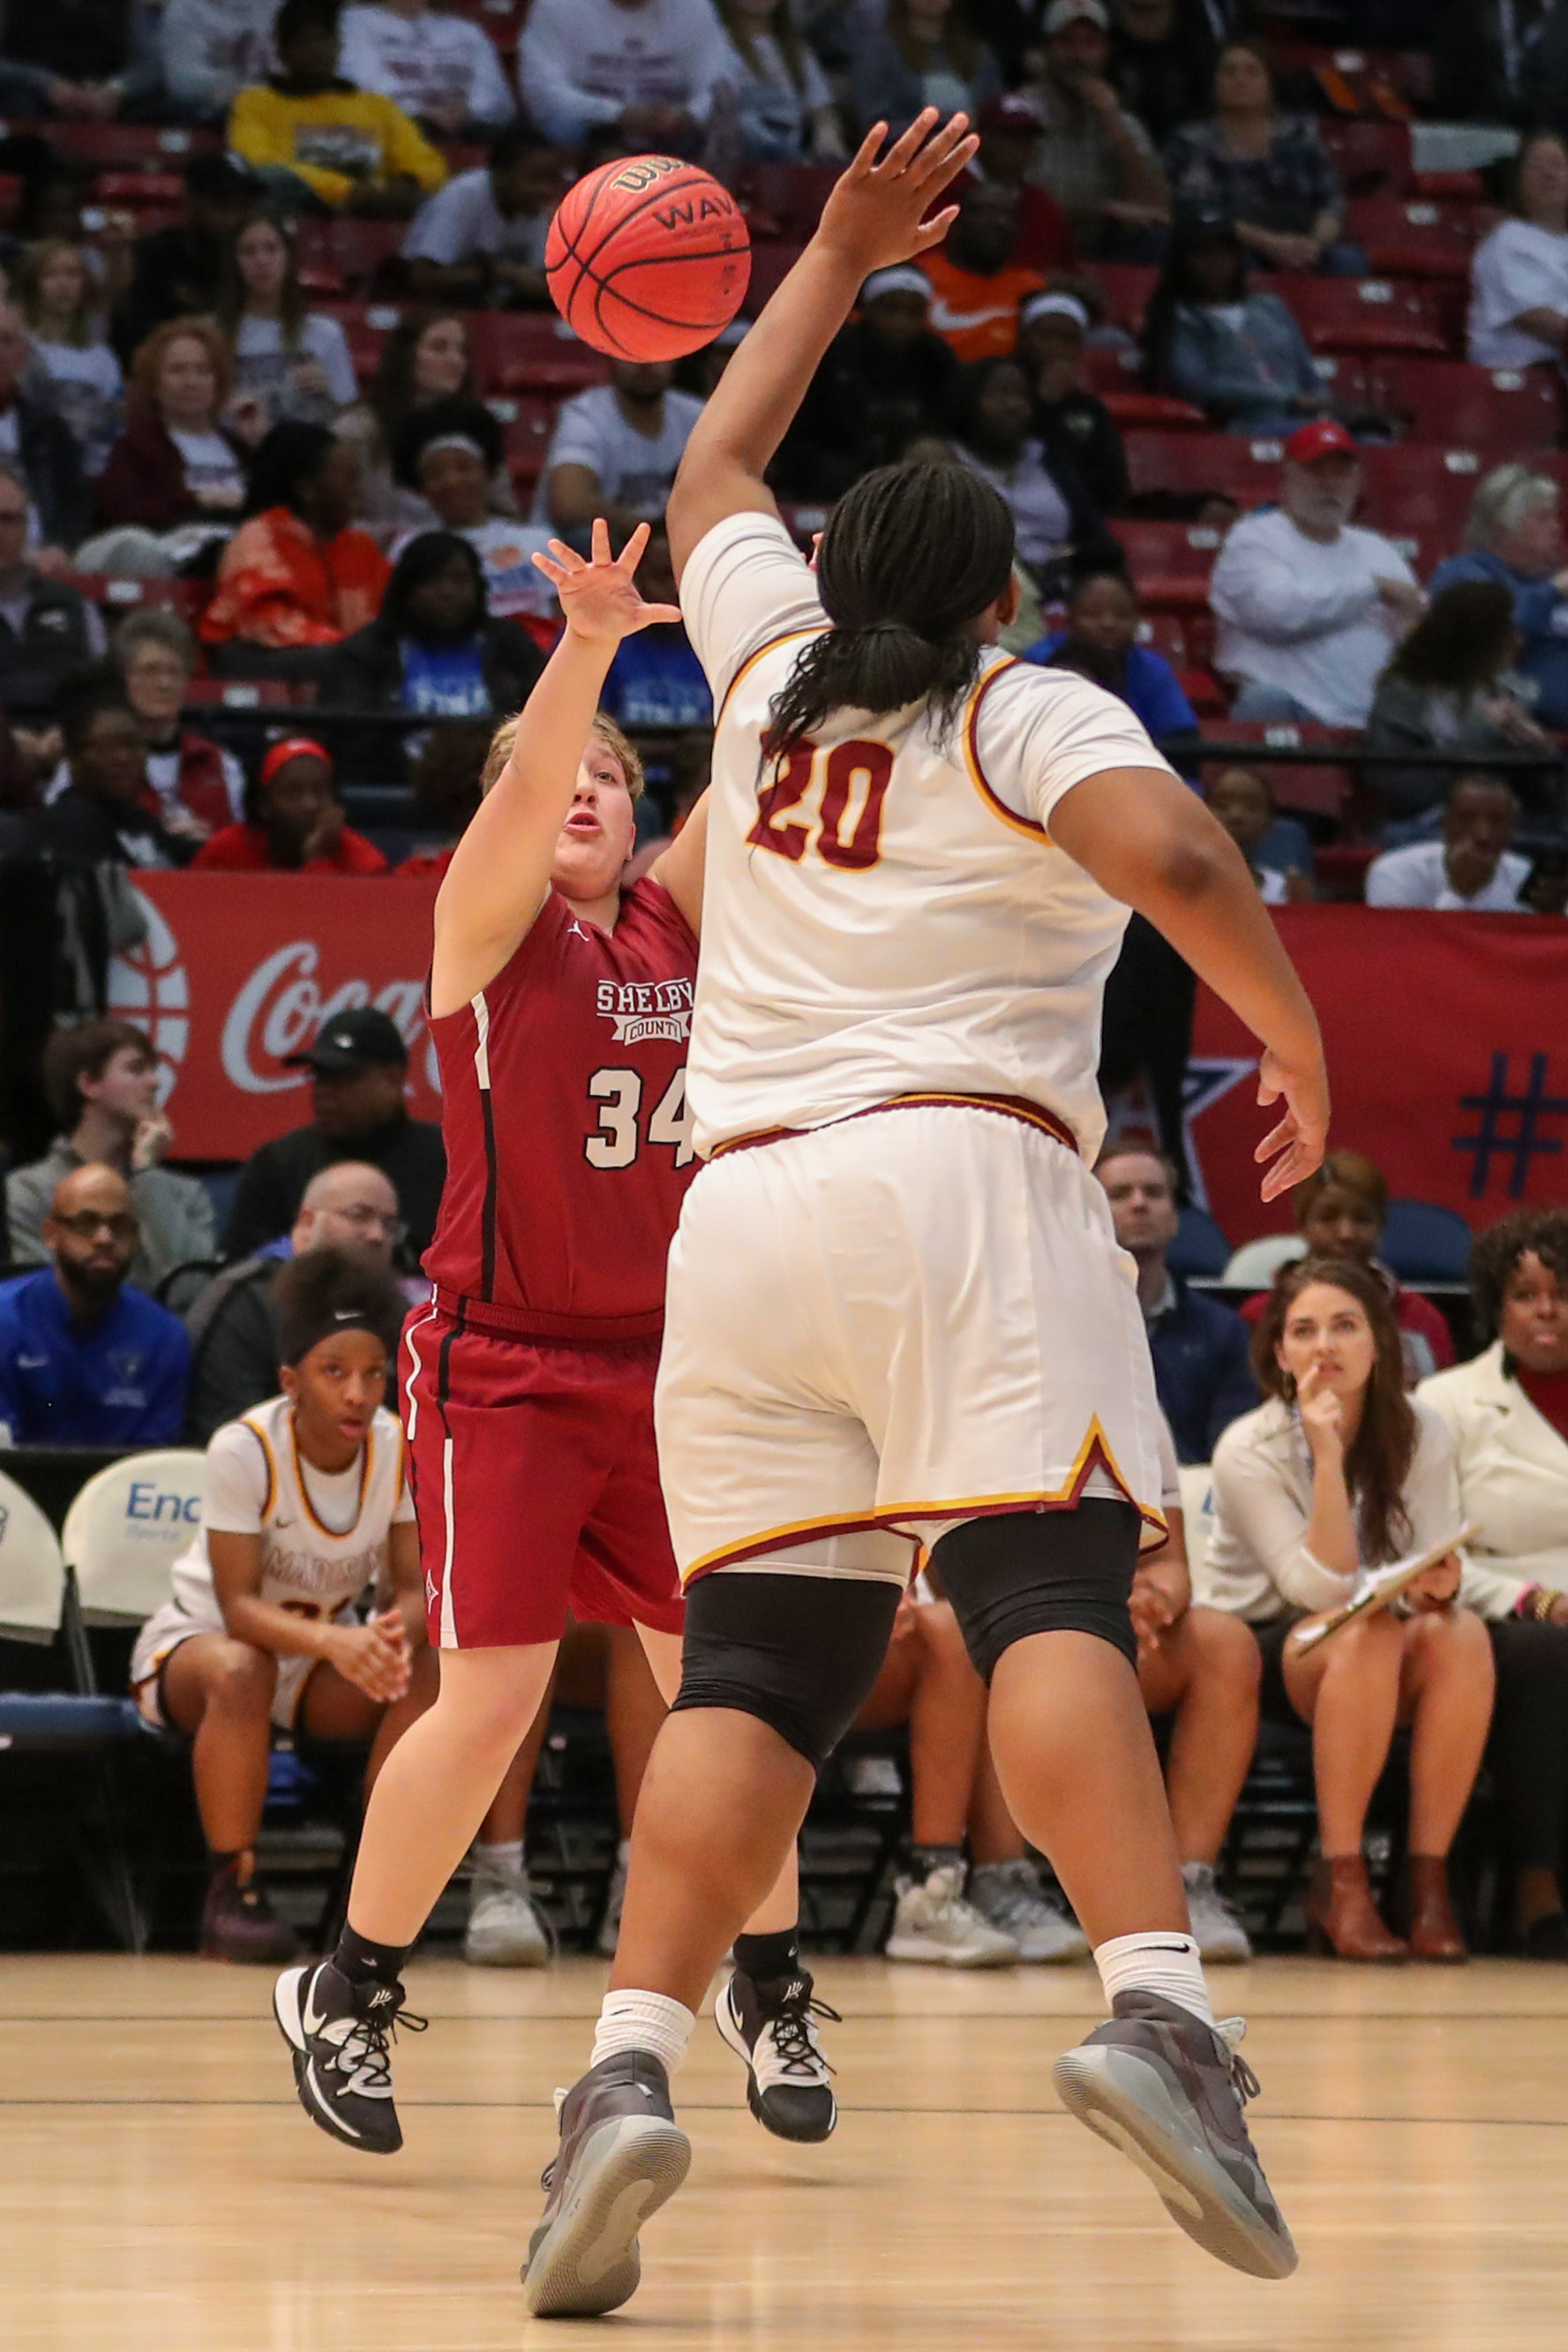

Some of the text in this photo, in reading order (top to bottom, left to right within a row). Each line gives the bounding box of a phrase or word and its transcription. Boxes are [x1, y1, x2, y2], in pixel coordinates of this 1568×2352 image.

[743, 727, 894, 874] 20
[596, 981, 694, 1012] SHELBY
[629, 1020, 678, 1041] COUNTY
[583, 1065, 696, 1170] 34
